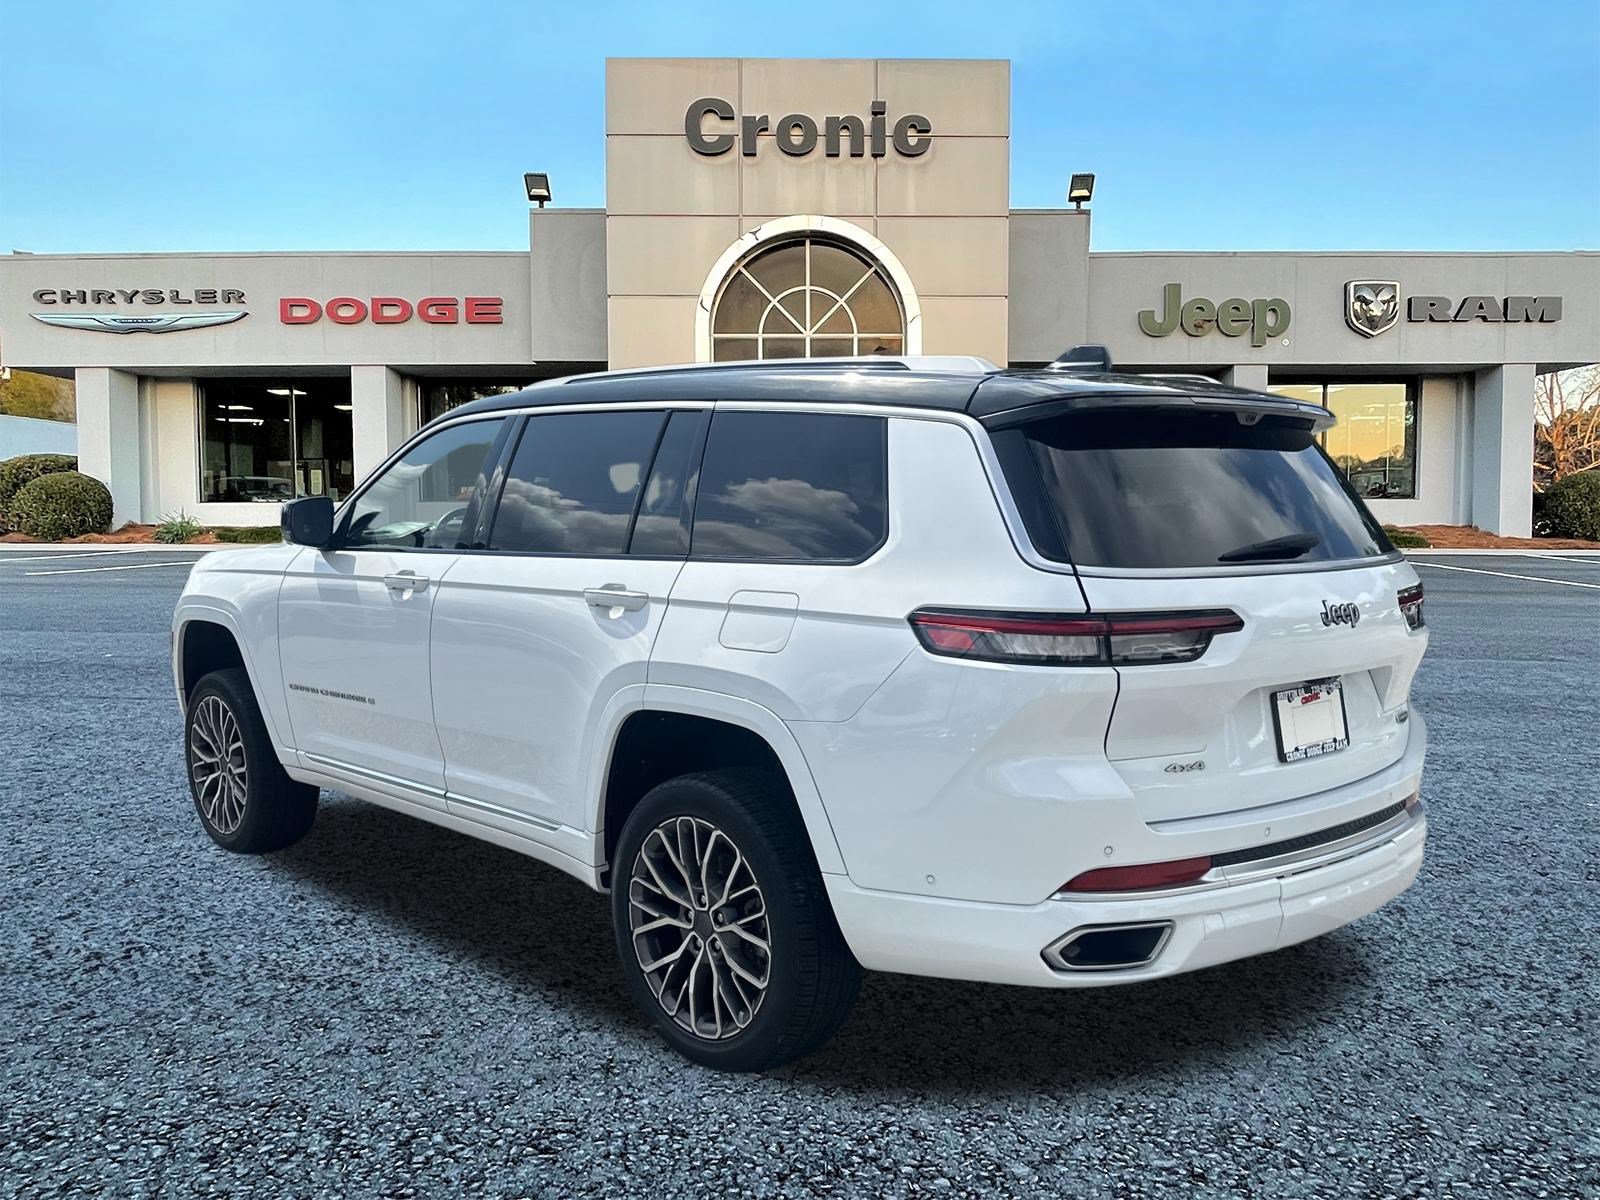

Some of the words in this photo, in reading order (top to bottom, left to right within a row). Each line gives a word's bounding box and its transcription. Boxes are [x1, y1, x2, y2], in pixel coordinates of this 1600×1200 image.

[685, 97, 932, 157] Cronic
[32, 289, 247, 305] CHRYSLER
[280, 297, 503, 325] DODGE
[1407, 296, 1562, 323] RAM
[1138, 283, 1291, 347] Jeep
[1319, 599, 1360, 628] Jeep
